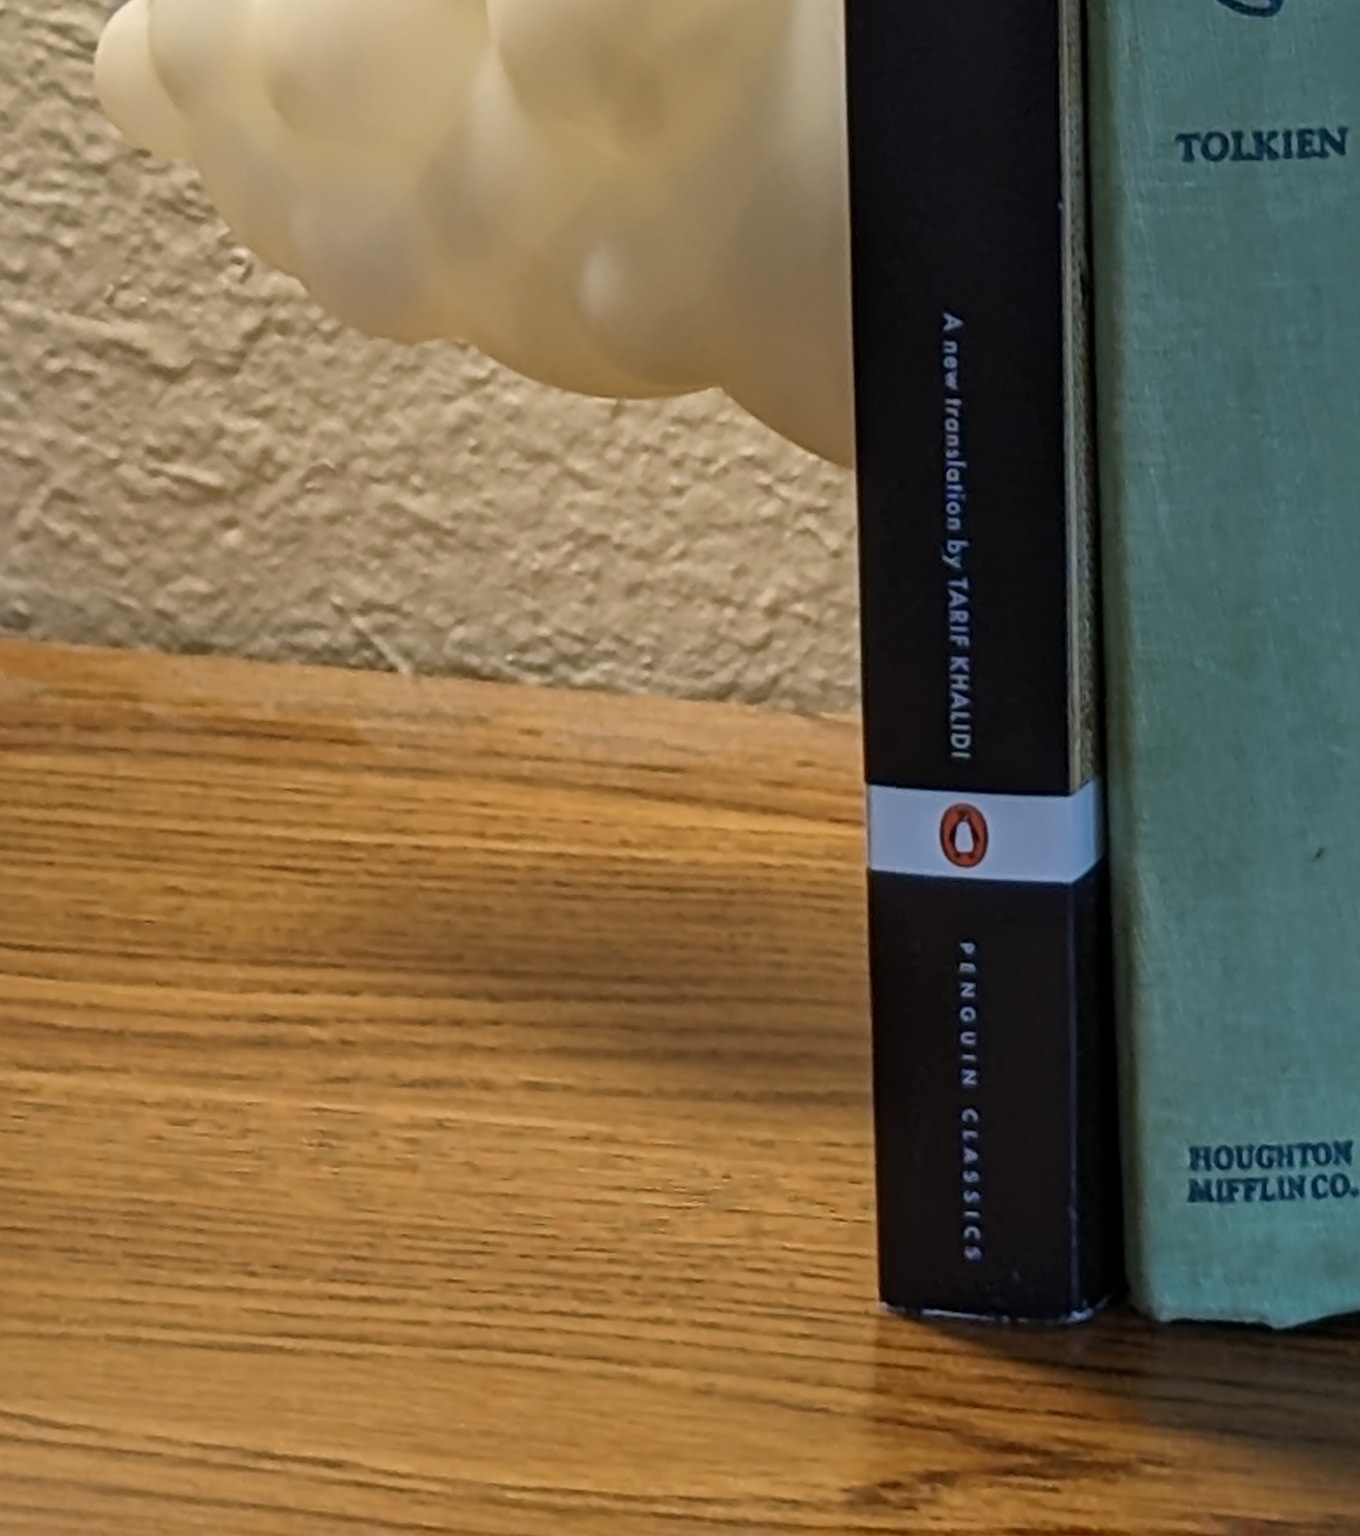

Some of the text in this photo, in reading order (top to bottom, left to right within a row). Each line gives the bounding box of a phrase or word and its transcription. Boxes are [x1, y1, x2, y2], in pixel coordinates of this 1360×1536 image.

[1174, 126, 1349, 165] TOLKIEN
[941, 312, 974, 760] A new translation by TARIF KHALIDI
[958, 941, 983, 1263] PENGUIN CLASSICS
[1188, 1140, 1353, 1171] HOUGHTON
[1187, 1172, 1360, 1204] MIFFLIN CO.
